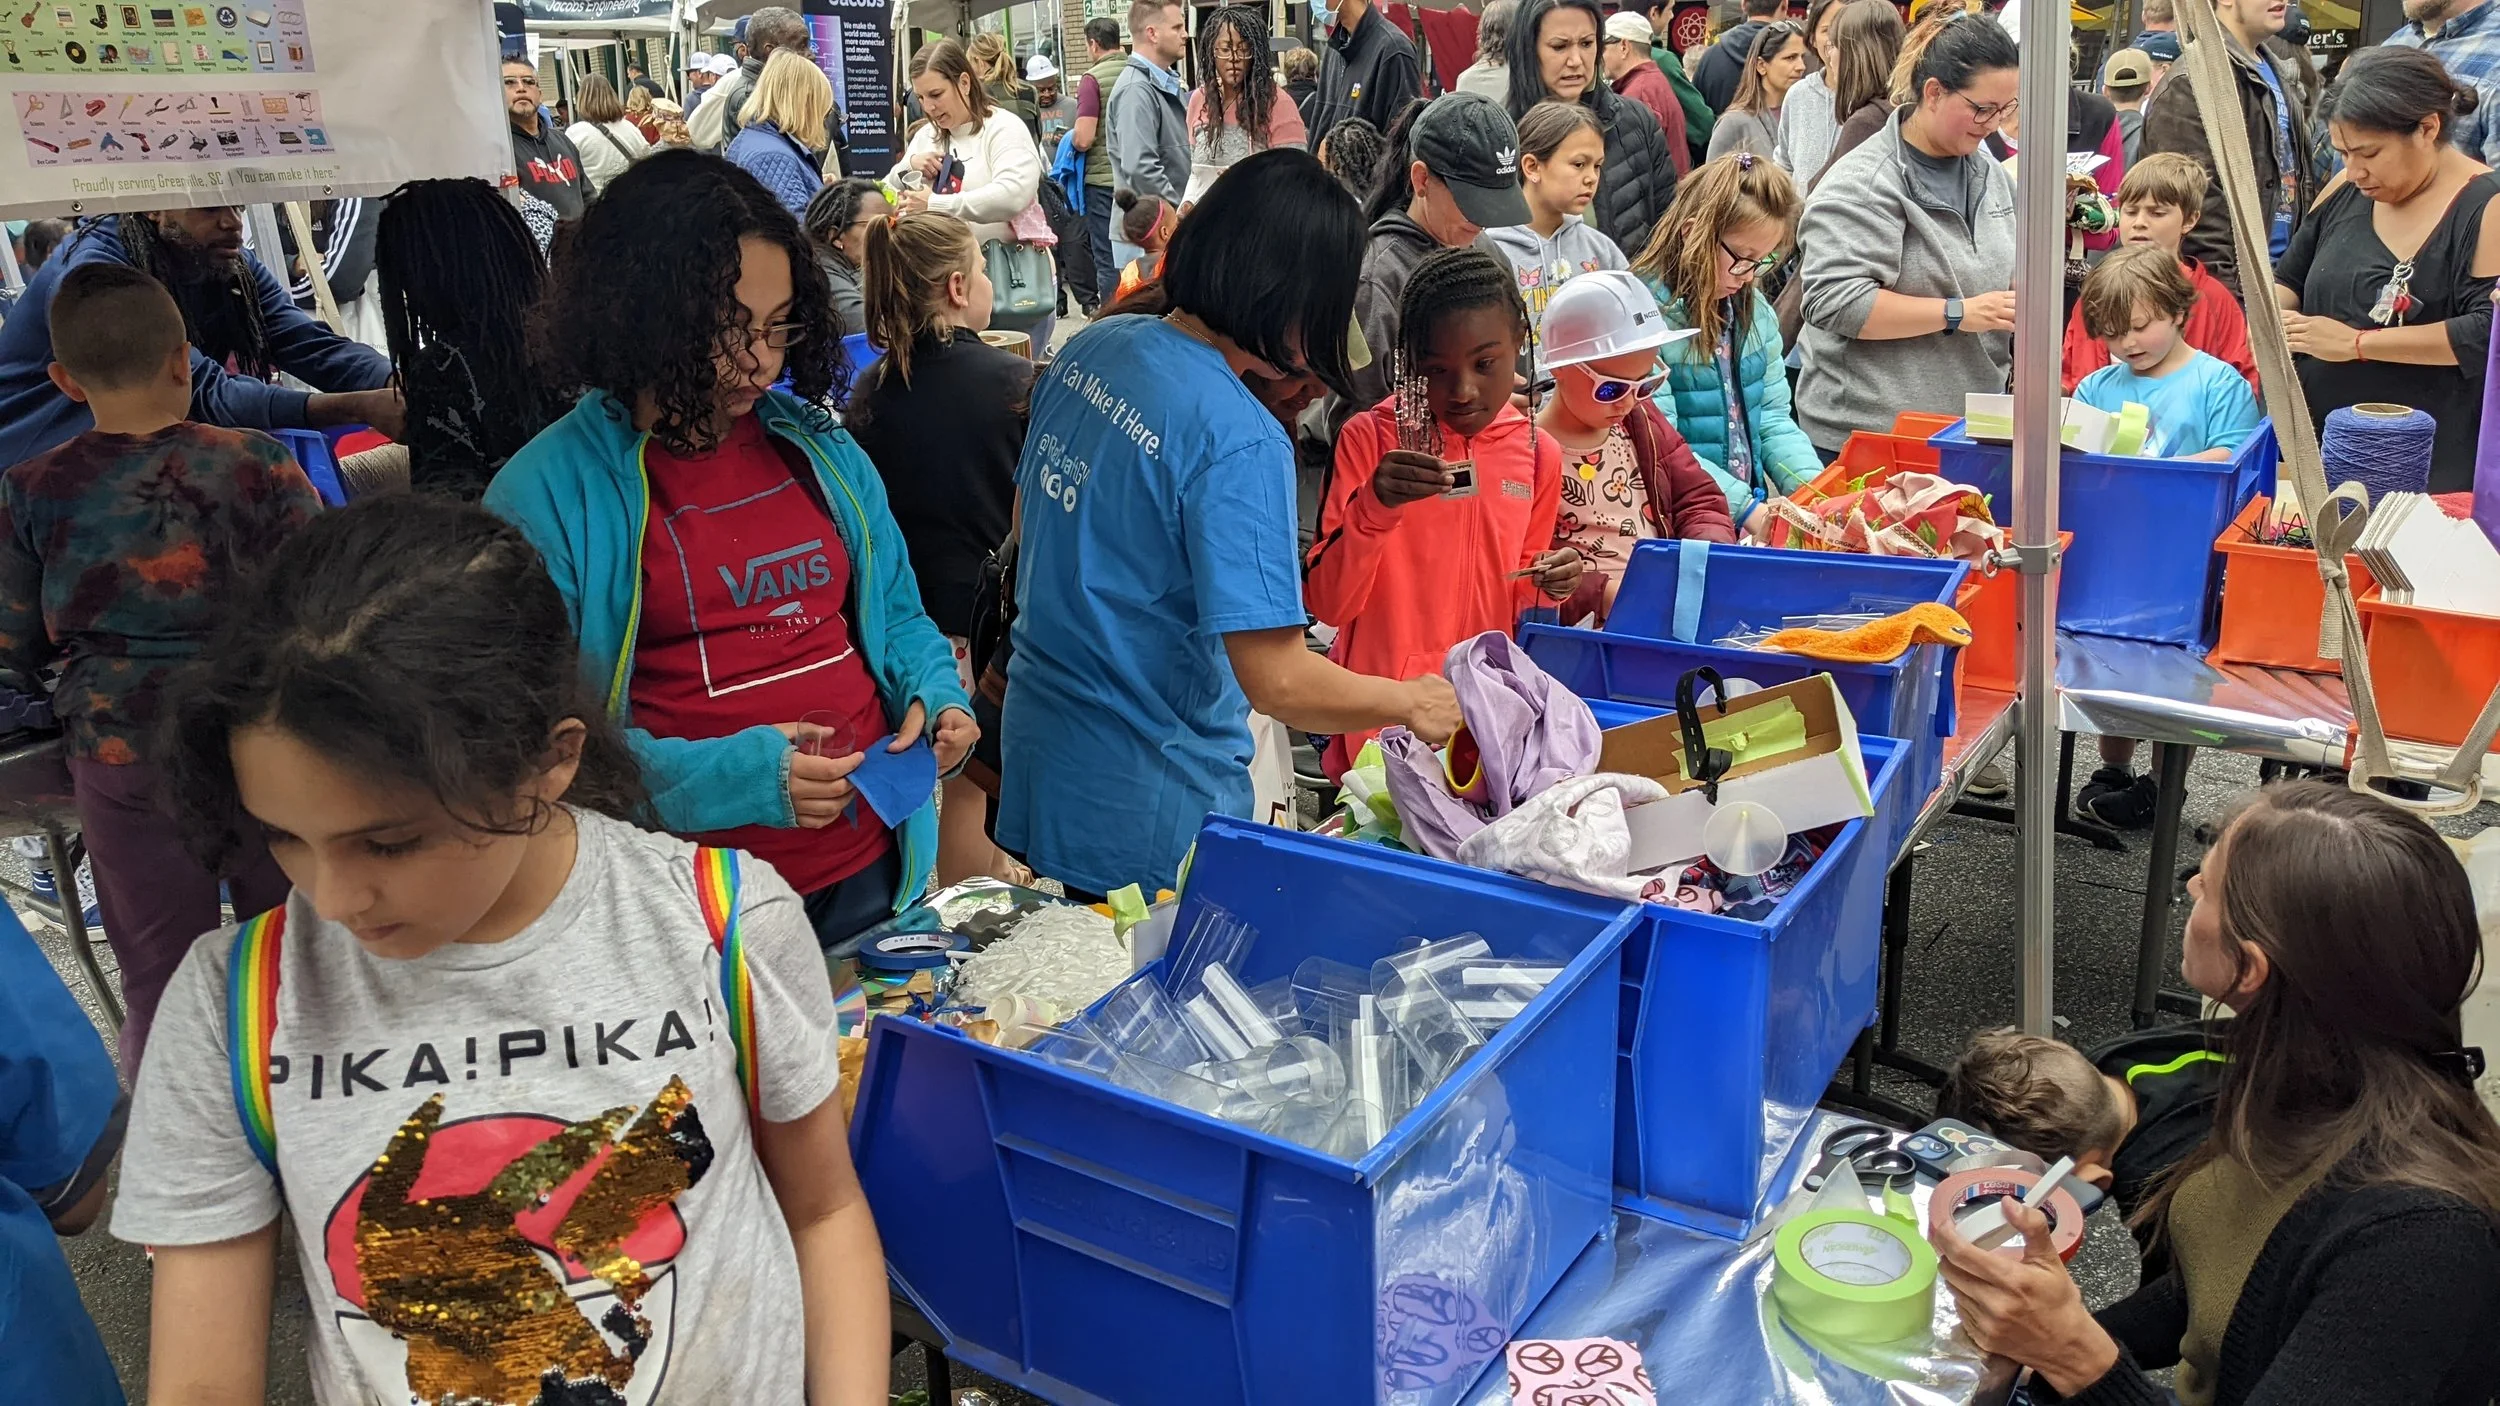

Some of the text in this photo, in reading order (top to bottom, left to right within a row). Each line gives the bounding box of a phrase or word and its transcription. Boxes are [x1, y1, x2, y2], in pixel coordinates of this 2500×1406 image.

[546, 0, 584, 12] Jacobs
[585, 0, 640, 17] Engineering
[1086, 2, 1092, 15] 2
[1496, 166, 1516, 174] adidas
[73, 177, 114, 193] Proudly
[118, 179, 156, 191] serving
[157, 174, 208, 188] Greenille,
[208, 172, 224, 186] SC
[237, 171, 256, 183] You
[260, 172, 275, 182] can
[278, 168, 302, 181] make
[304, 168, 311, 179] it
[1082, 373, 1113, 414] Make
[1110, 398, 1127, 425] It
[1120, 408, 1160, 460] Here.
[717, 539, 831, 608] VANS
[786, 617, 809, 627] THE
